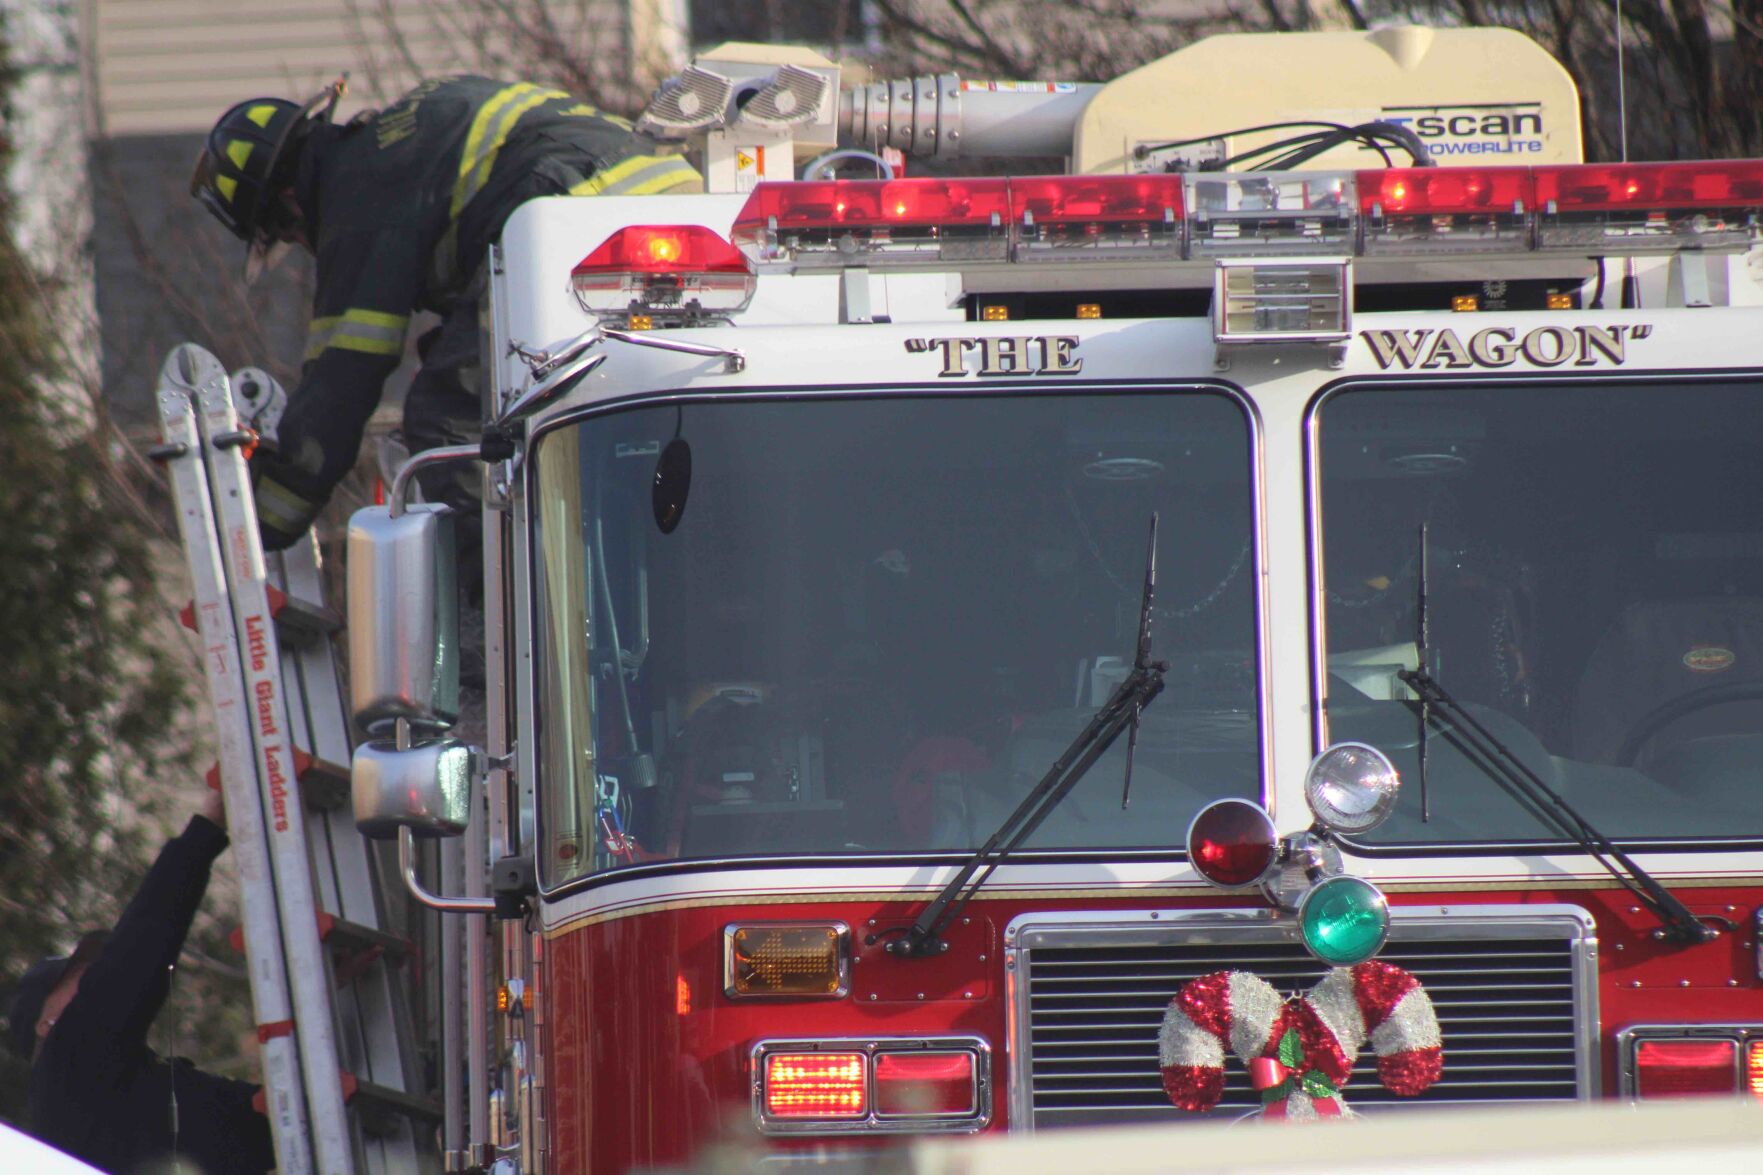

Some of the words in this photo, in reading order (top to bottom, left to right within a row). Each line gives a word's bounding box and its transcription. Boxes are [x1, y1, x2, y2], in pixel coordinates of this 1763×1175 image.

[245, 614, 267, 672] Little
[255, 680, 278, 736] Giant
[264, 745, 289, 832] Ladders
